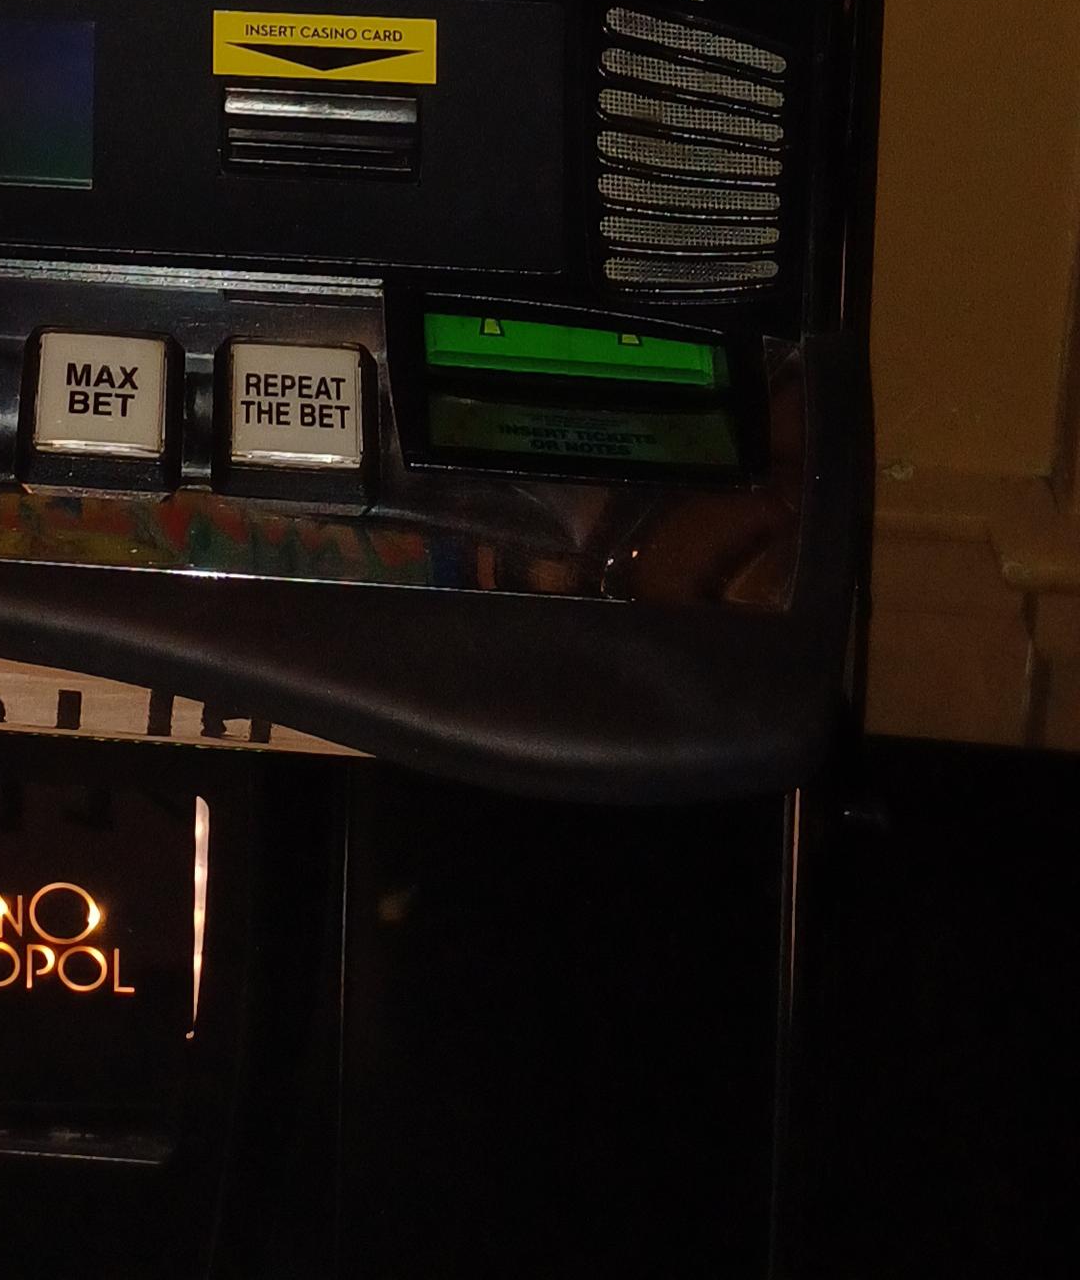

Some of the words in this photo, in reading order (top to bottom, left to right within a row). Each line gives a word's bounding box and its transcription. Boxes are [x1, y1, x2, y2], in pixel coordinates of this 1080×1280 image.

[245, 23, 297, 39] INSERT
[300, 25, 358, 41] CASINO
[361, 29, 403, 43] CARD
[66, 362, 139, 390] MAX
[245, 372, 347, 401] REPEAT
[68, 391, 135, 418] BET
[240, 400, 291, 426] THE
[299, 401, 351, 430] BET
[564, 441, 632, 456] NOTES
